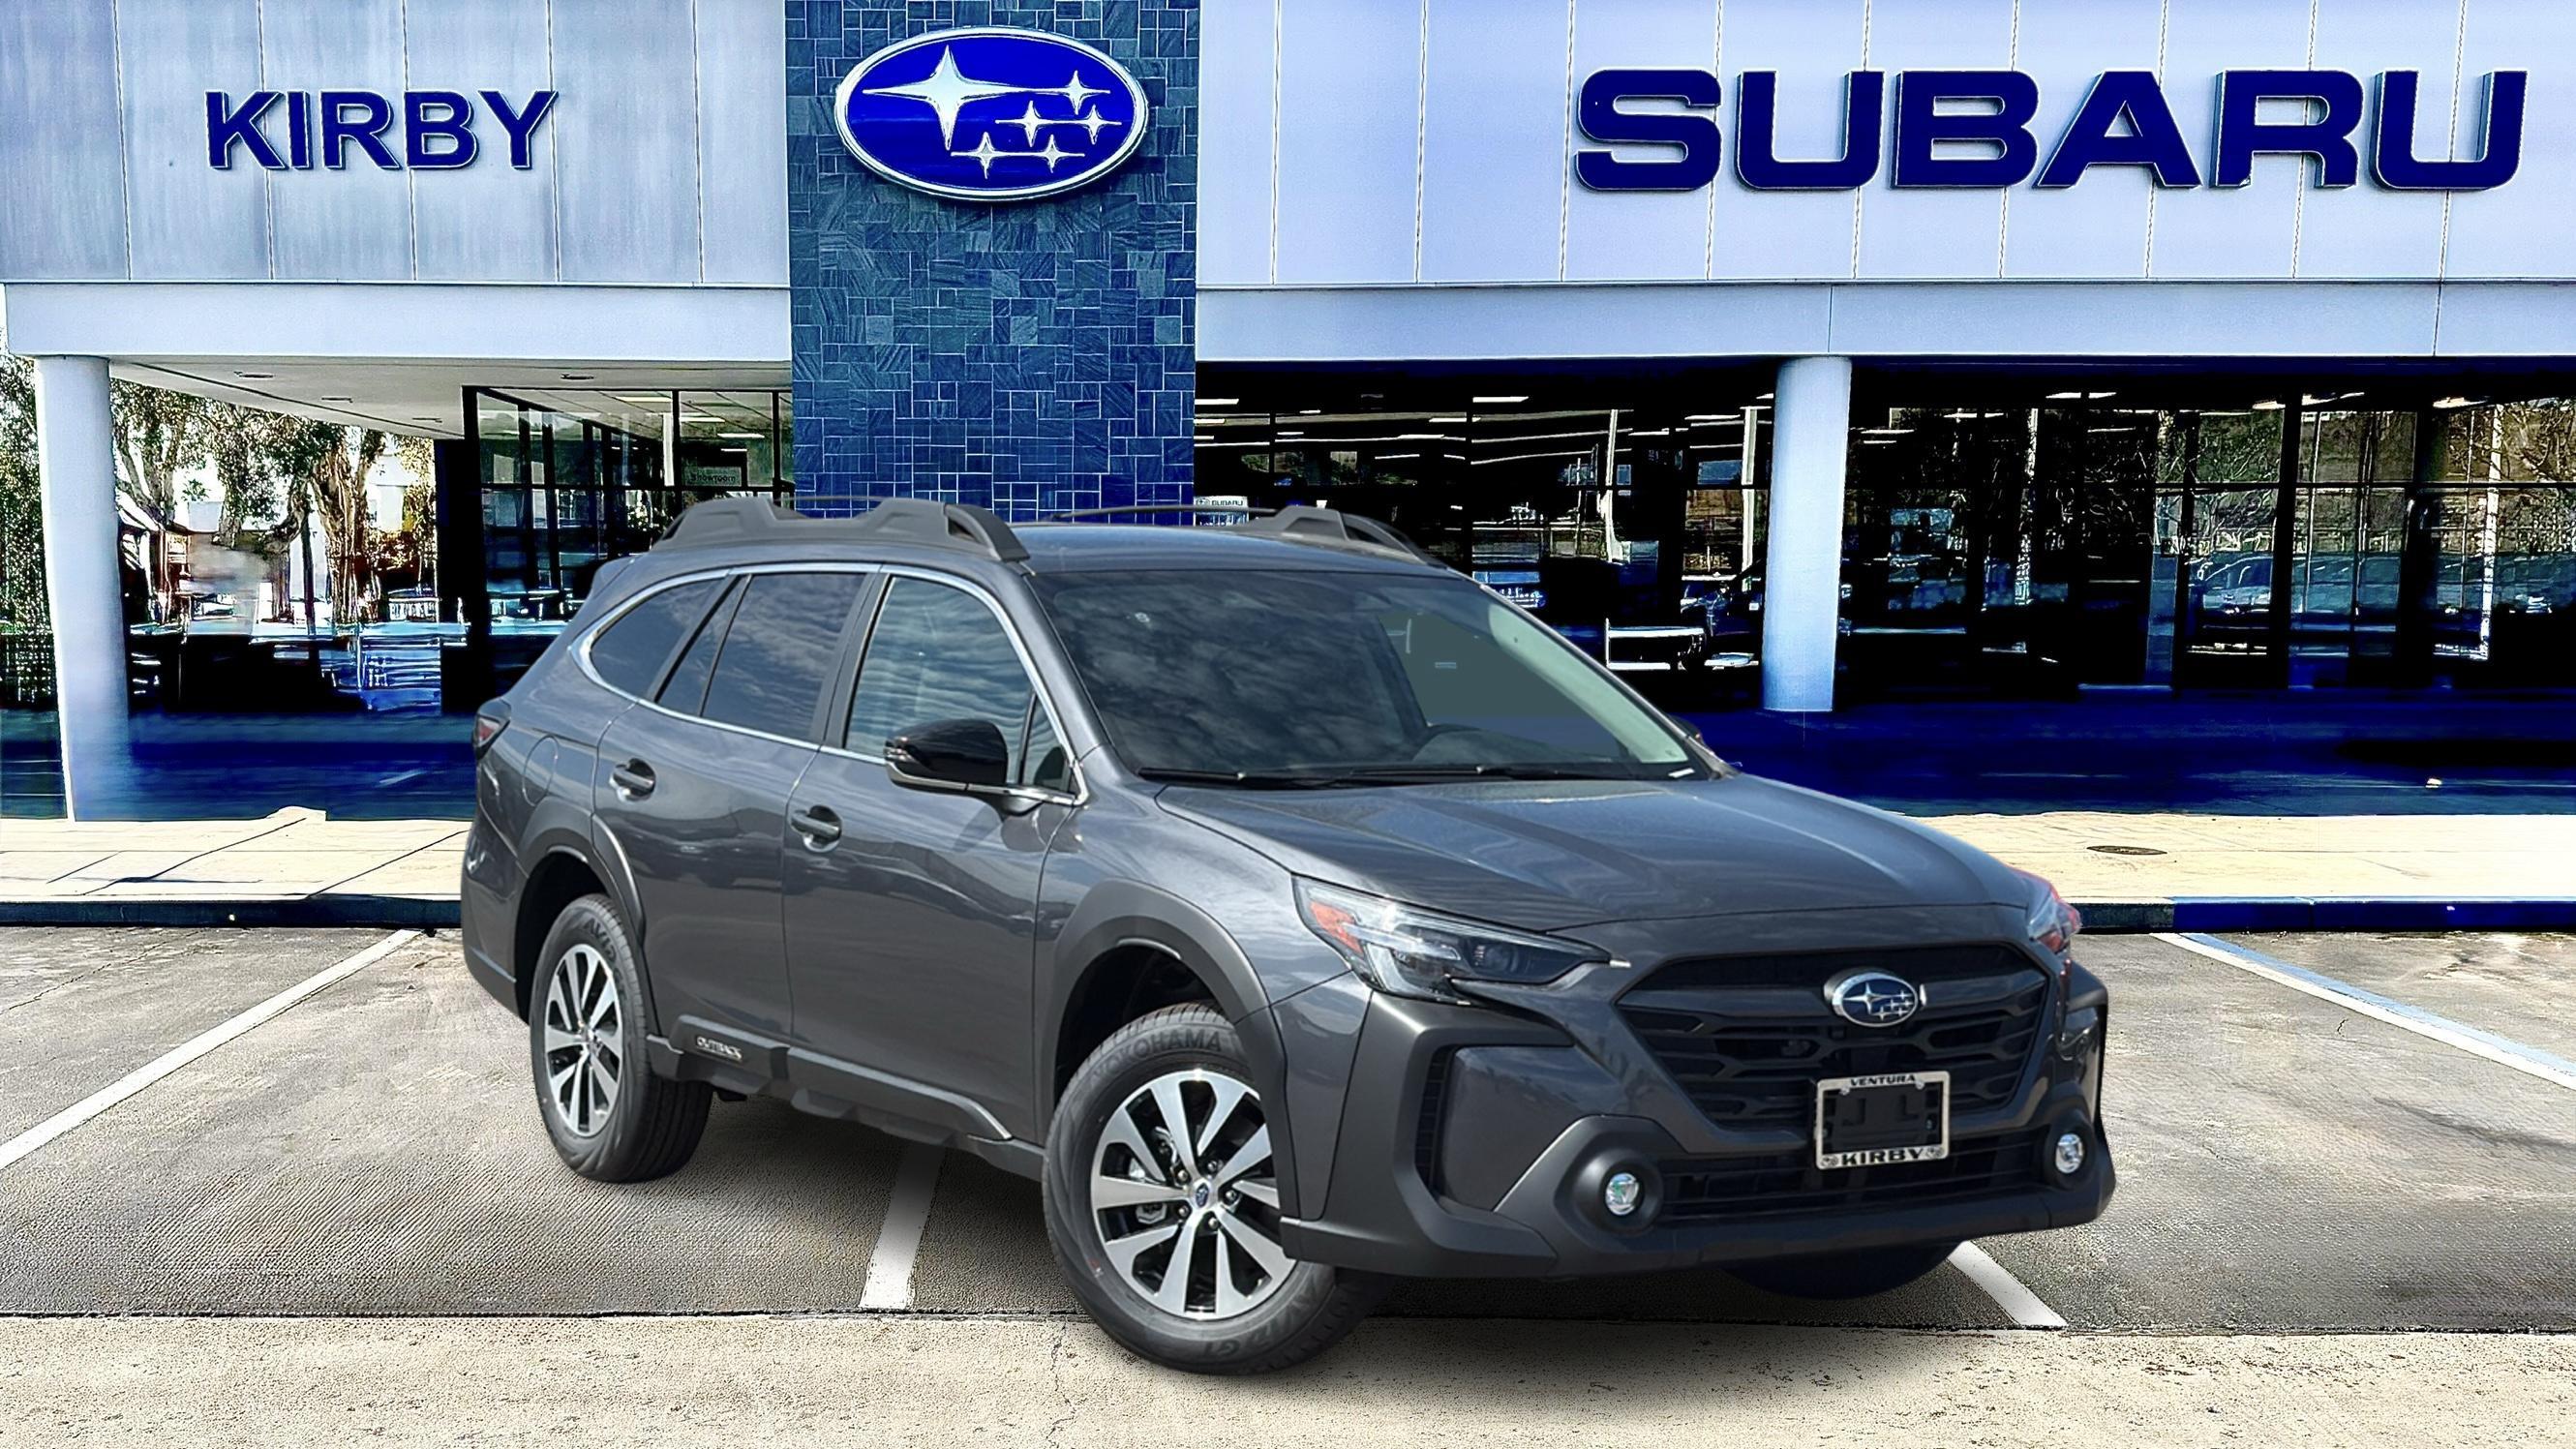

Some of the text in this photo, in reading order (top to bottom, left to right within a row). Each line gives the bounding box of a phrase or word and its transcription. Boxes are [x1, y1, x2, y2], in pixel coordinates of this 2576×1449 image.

[204, 90, 559, 169] KIRBY
[1575, 69, 2529, 191] SUBARU
[1091, 1029, 1223, 1083] YOKOHAMA
[1850, 1074, 1916, 1087] VENTURA
[1841, 1148, 1924, 1166] KIRBY
